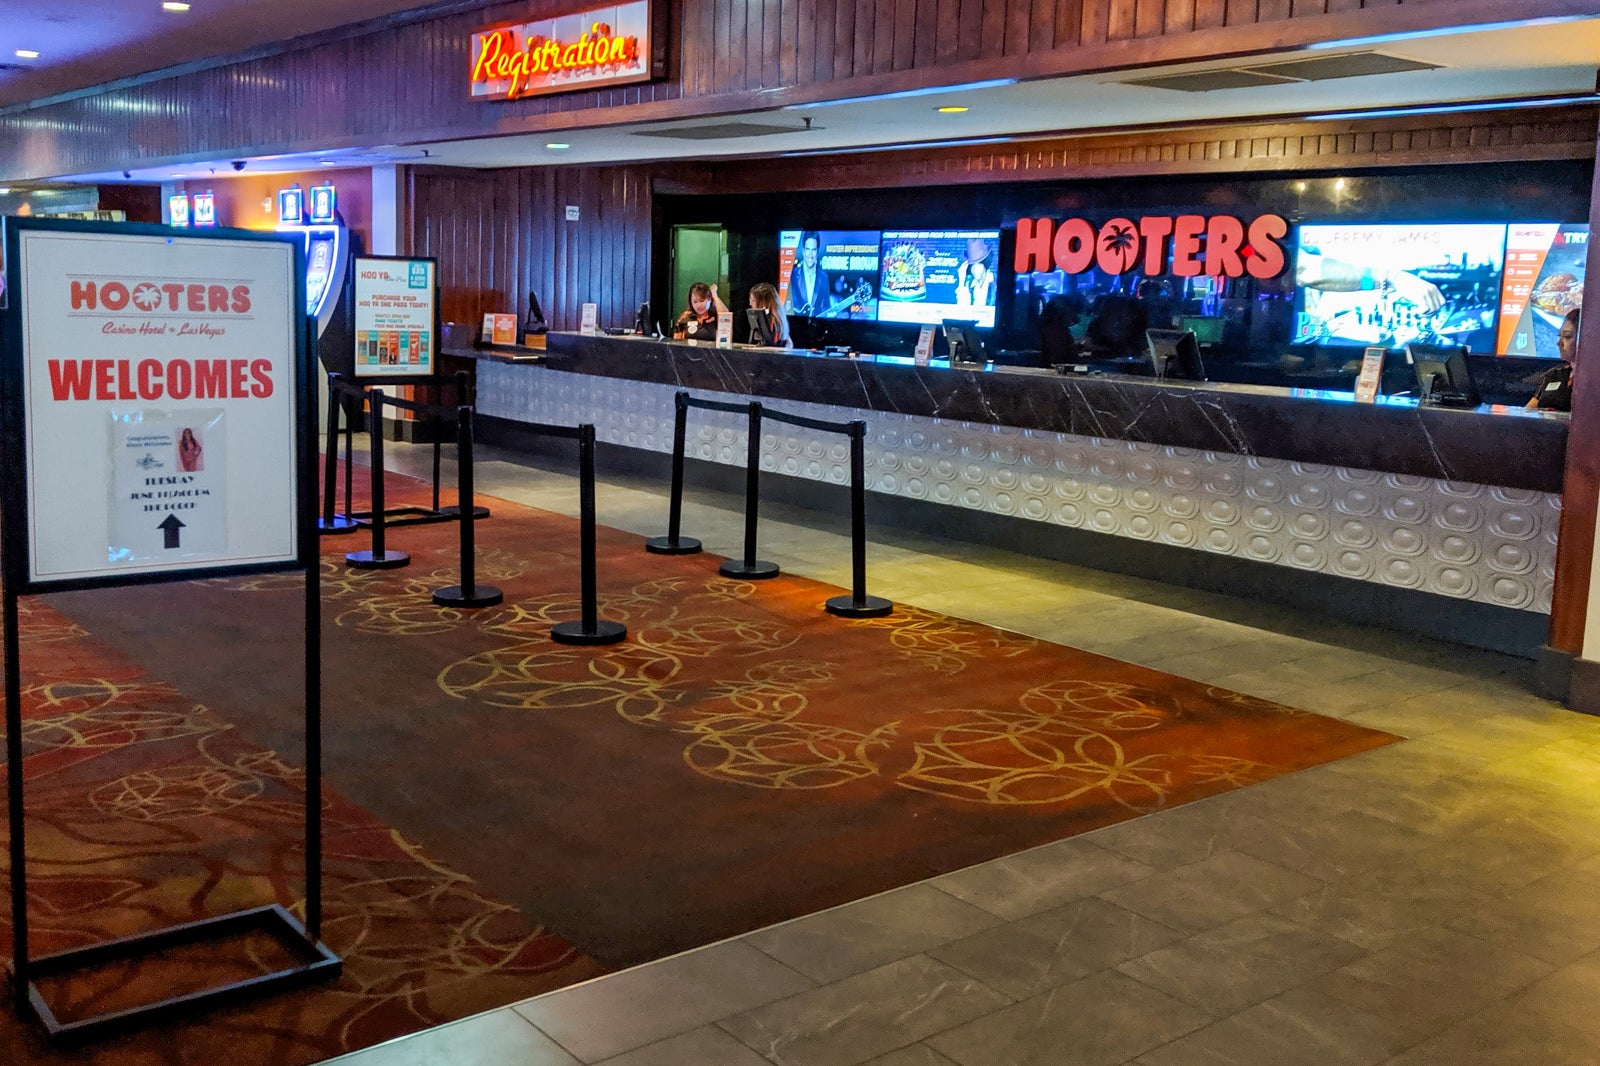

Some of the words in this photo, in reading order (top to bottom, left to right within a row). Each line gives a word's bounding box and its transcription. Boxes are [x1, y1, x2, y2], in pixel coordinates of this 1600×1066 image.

[472, 21, 628, 98] Registration
[1014, 214, 1288, 279] HOOTERS
[361, 271, 377, 279] HOO
[70, 280, 251, 314] HOOTERS
[102, 321, 137, 335] Casino
[139, 321, 166, 335] Hotel
[176, 322, 199, 337] Las
[198, 322, 226, 340] Vegas
[48, 358, 274, 401] WELCOMES
[145, 476, 194, 486] TUESDAY
[131, 491, 153, 500] JUNE
